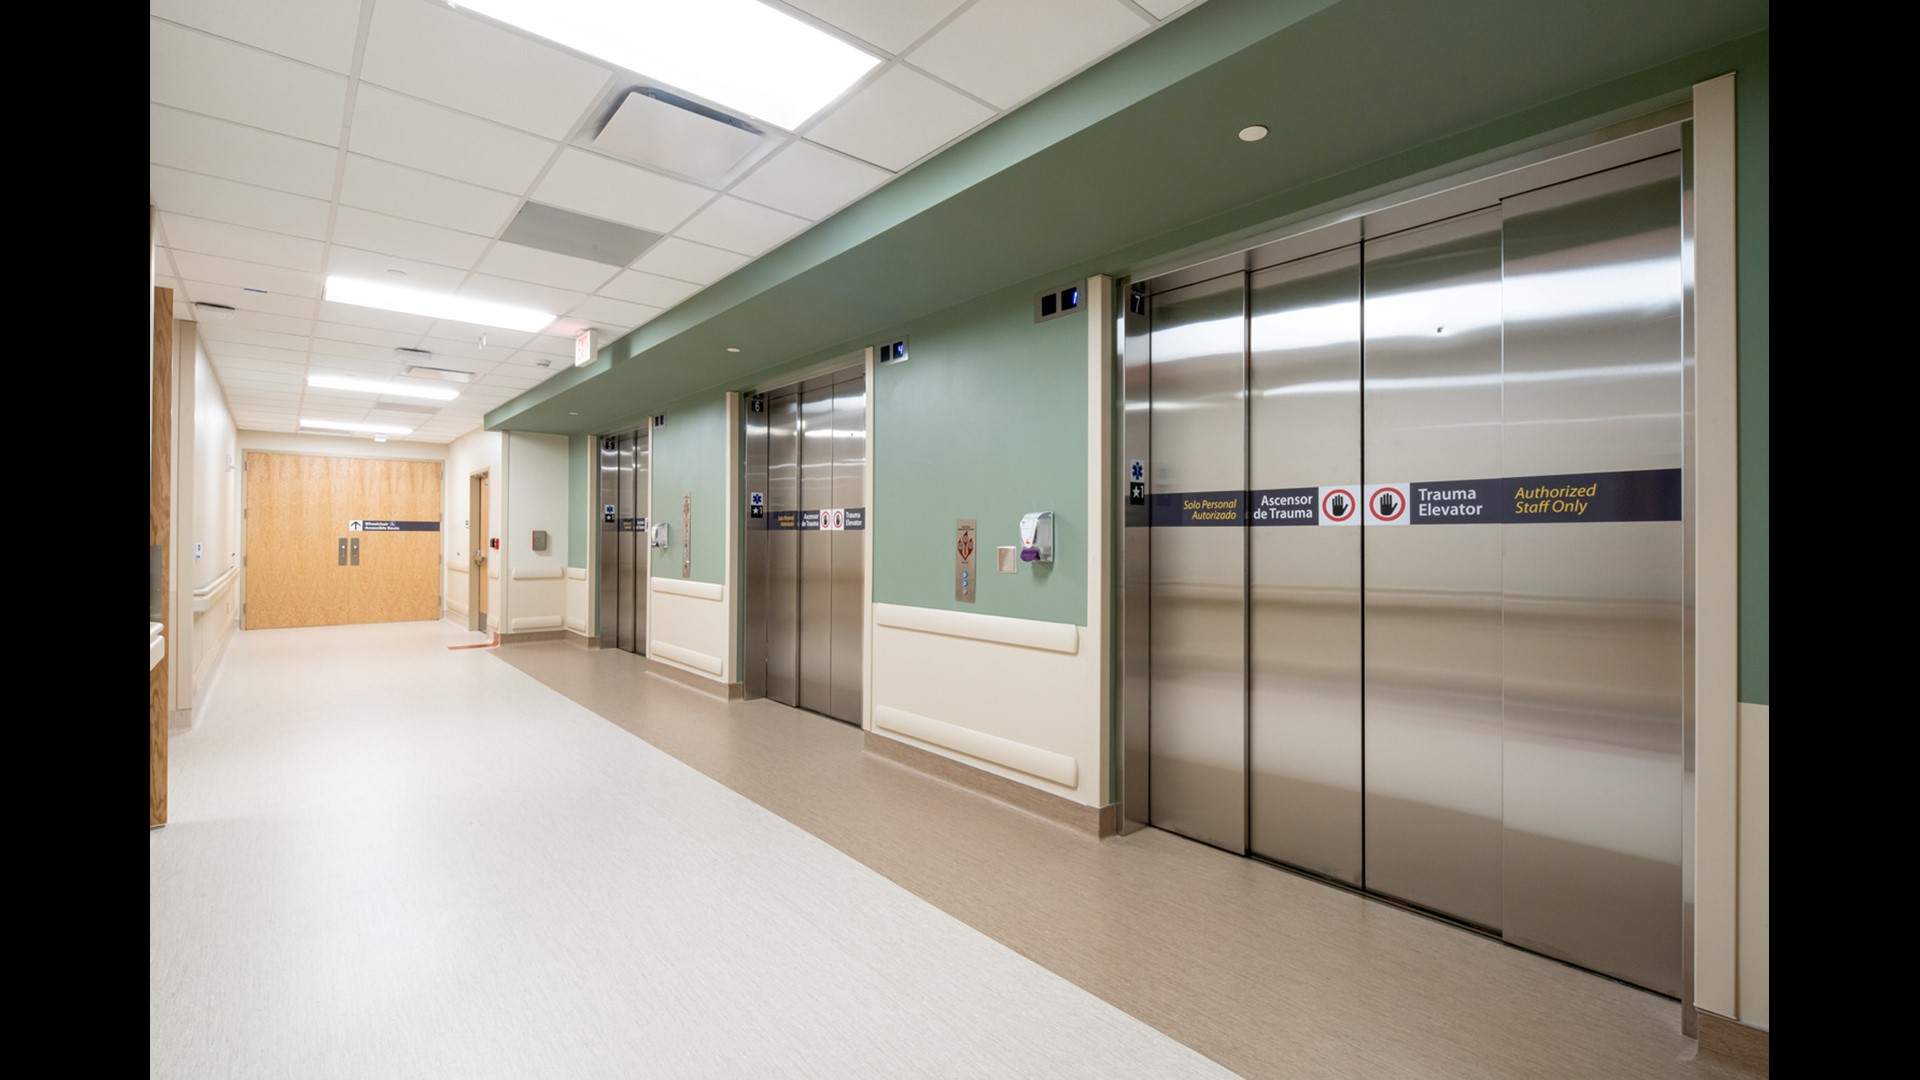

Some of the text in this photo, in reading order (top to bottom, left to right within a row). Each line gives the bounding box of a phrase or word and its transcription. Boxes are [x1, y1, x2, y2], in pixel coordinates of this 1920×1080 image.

[1134, 295, 1141, 313] 7
[755, 401, 761, 412] 6
[1418, 488, 1477, 501] Trauma
[1514, 483, 1597, 500] Authorized
[1183, 499, 1238, 510] Solo Personal
[1261, 495, 1314, 506] Ascensor
[1418, 503, 1483, 516] Elevator
[1515, 499, 1588, 516] Staff Only
[845, 511, 861, 519] Trauma
[1192, 510, 1237, 520] Autorizado
[1253, 508, 1313, 520] de Trauma
[845, 519, 862, 527] Elevator
